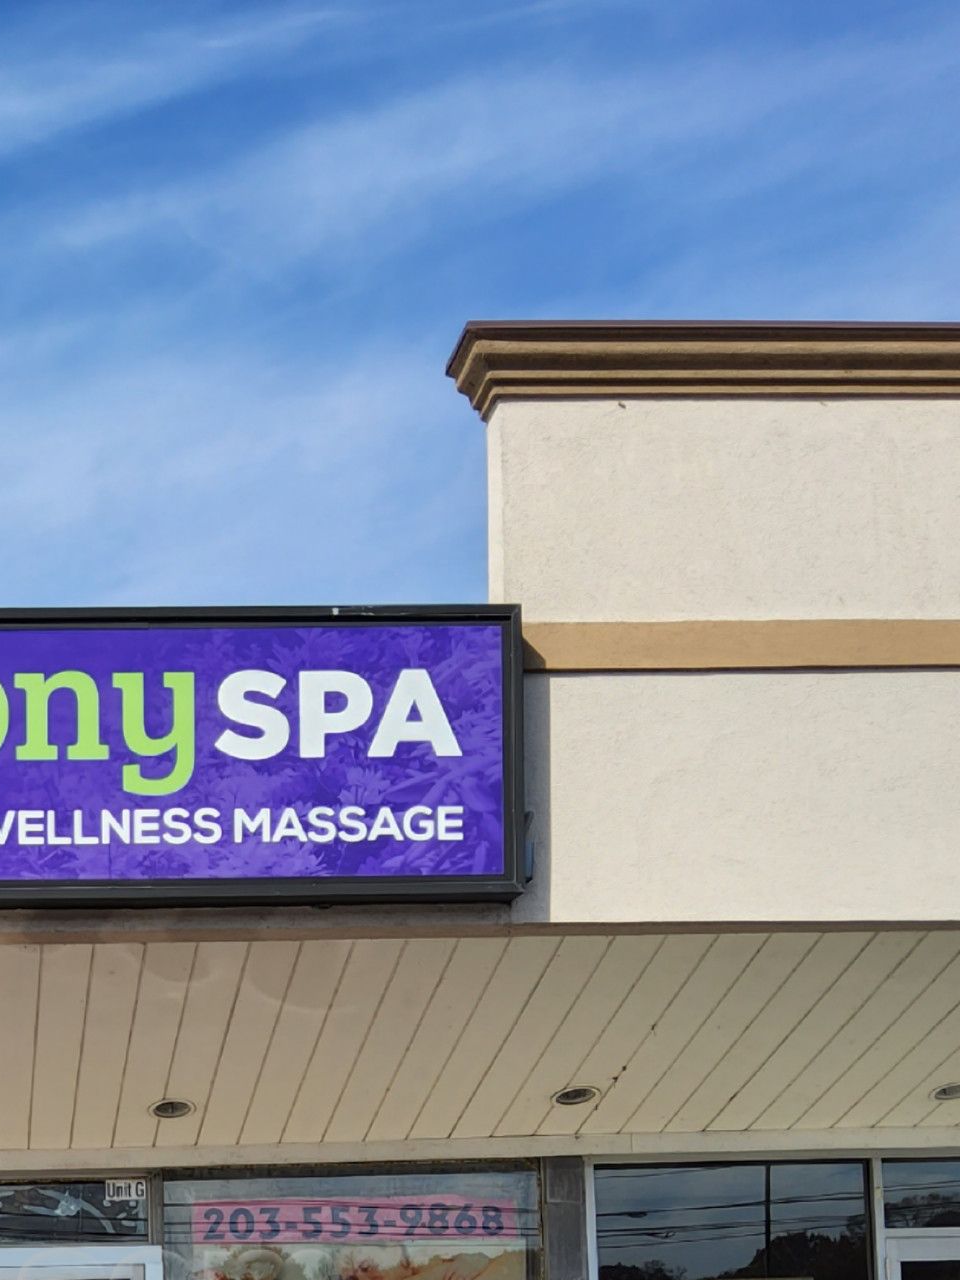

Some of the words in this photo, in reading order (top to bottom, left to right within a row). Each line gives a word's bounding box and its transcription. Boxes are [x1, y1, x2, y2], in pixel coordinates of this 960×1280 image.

[215, 669, 463, 761] SPA
[234, 805, 464, 844] MASSAGE
[106, 1182, 131, 1198] Unit
[135, 1181, 145, 1198] G
[202, 1203, 504, 1241] 203-553-9868
